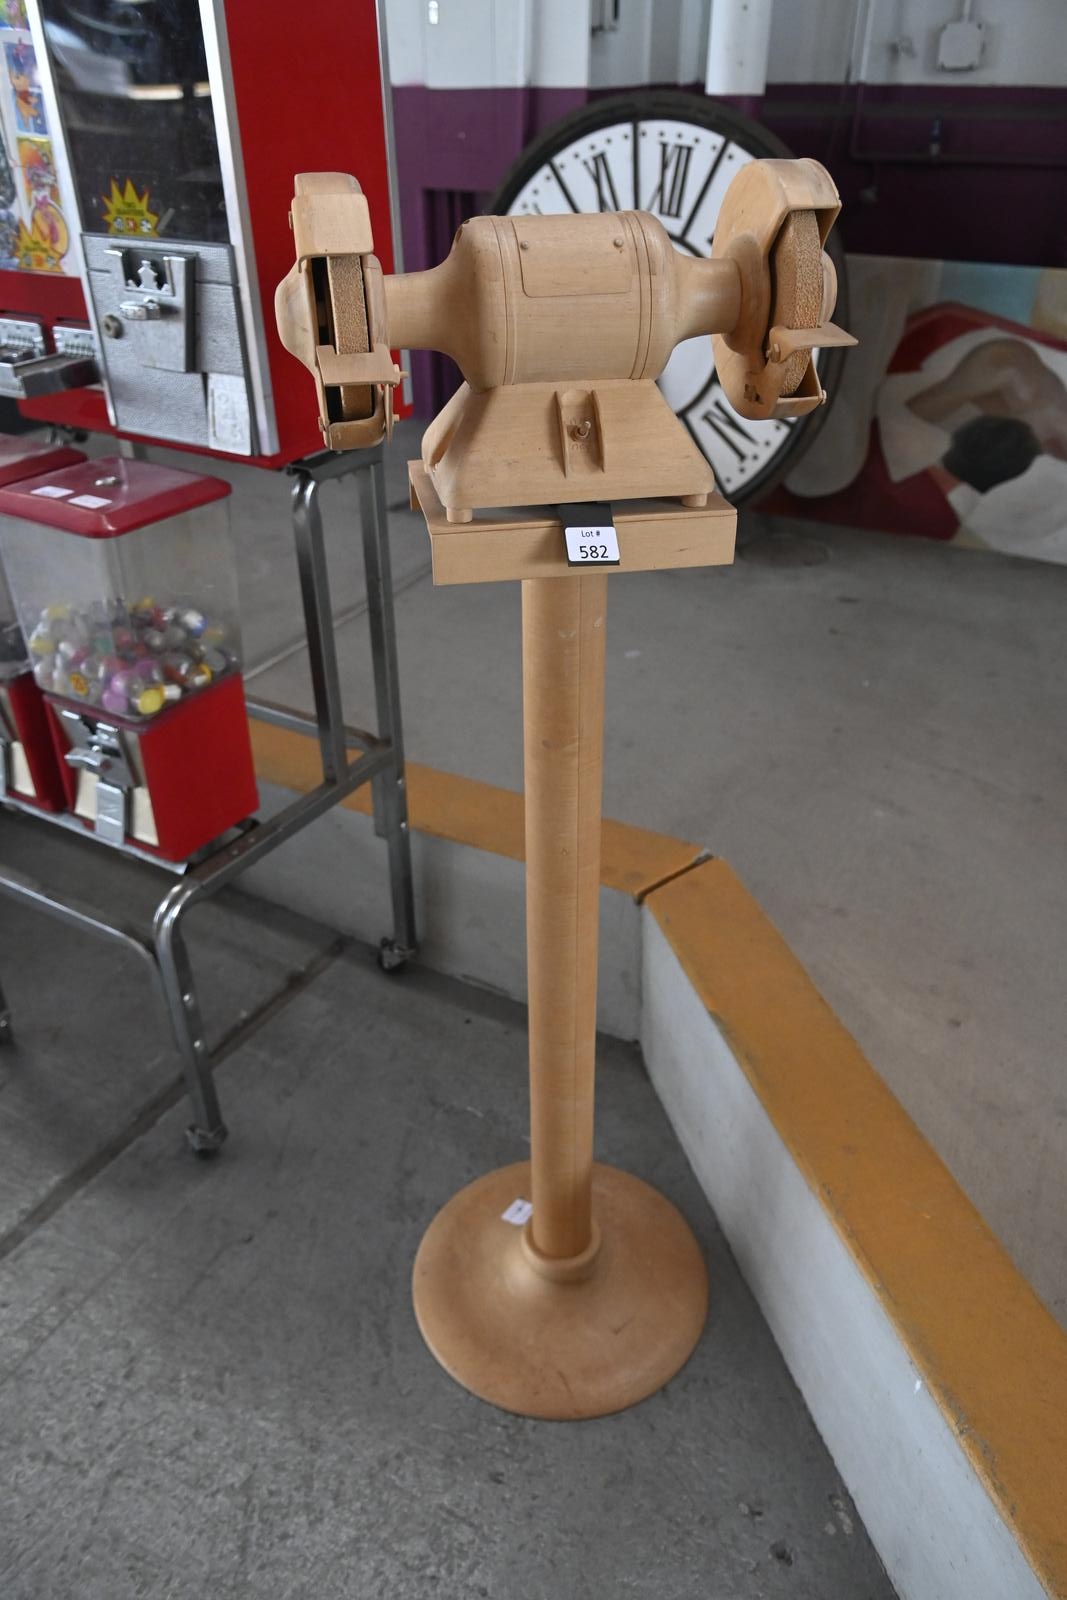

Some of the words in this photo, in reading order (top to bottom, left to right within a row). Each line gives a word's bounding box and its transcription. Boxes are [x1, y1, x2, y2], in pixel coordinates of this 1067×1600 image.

[647, 142, 694, 218] XII
[581, 530, 594, 538] Lot
[579, 545, 609, 559] 582
